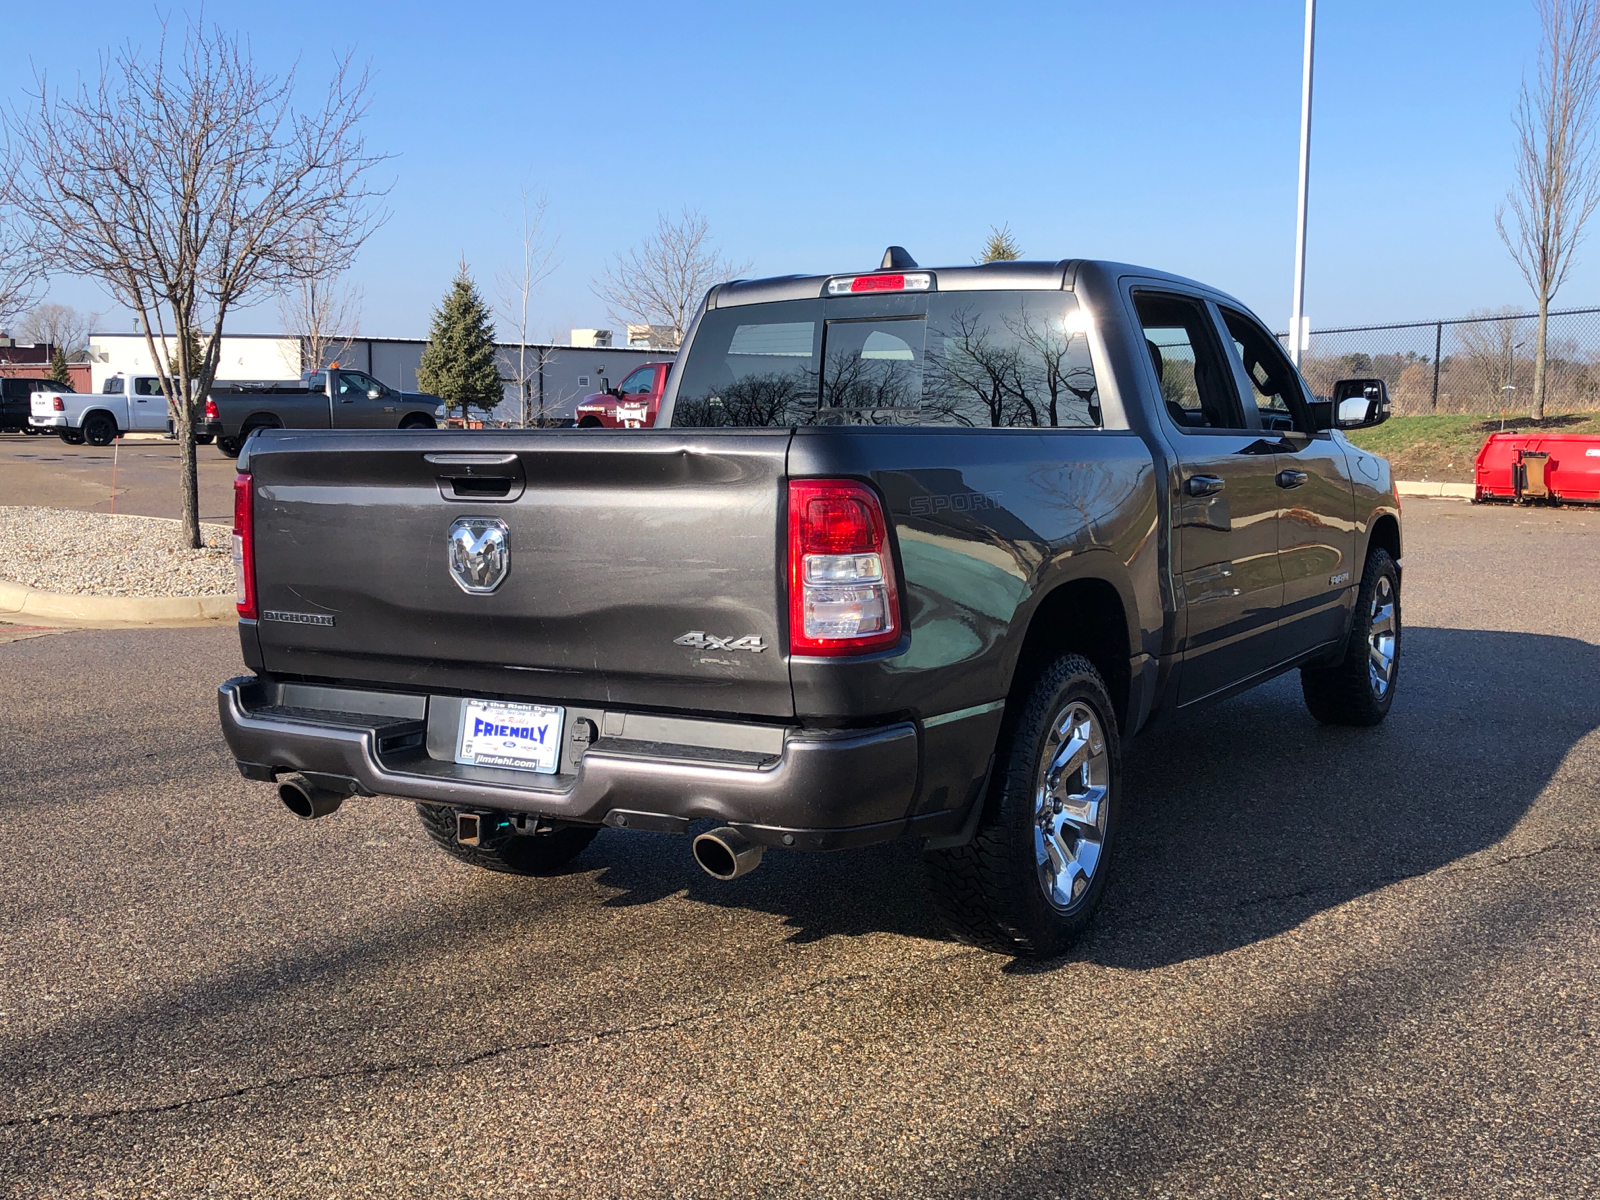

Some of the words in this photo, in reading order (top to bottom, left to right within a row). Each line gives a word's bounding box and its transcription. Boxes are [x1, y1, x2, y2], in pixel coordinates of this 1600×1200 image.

[909, 491, 1003, 516] SPORT
[263, 610, 334, 627] BIGHORN
[473, 717, 549, 745] FRIENDLY
[476, 755, 536, 768] jimriehl.com
